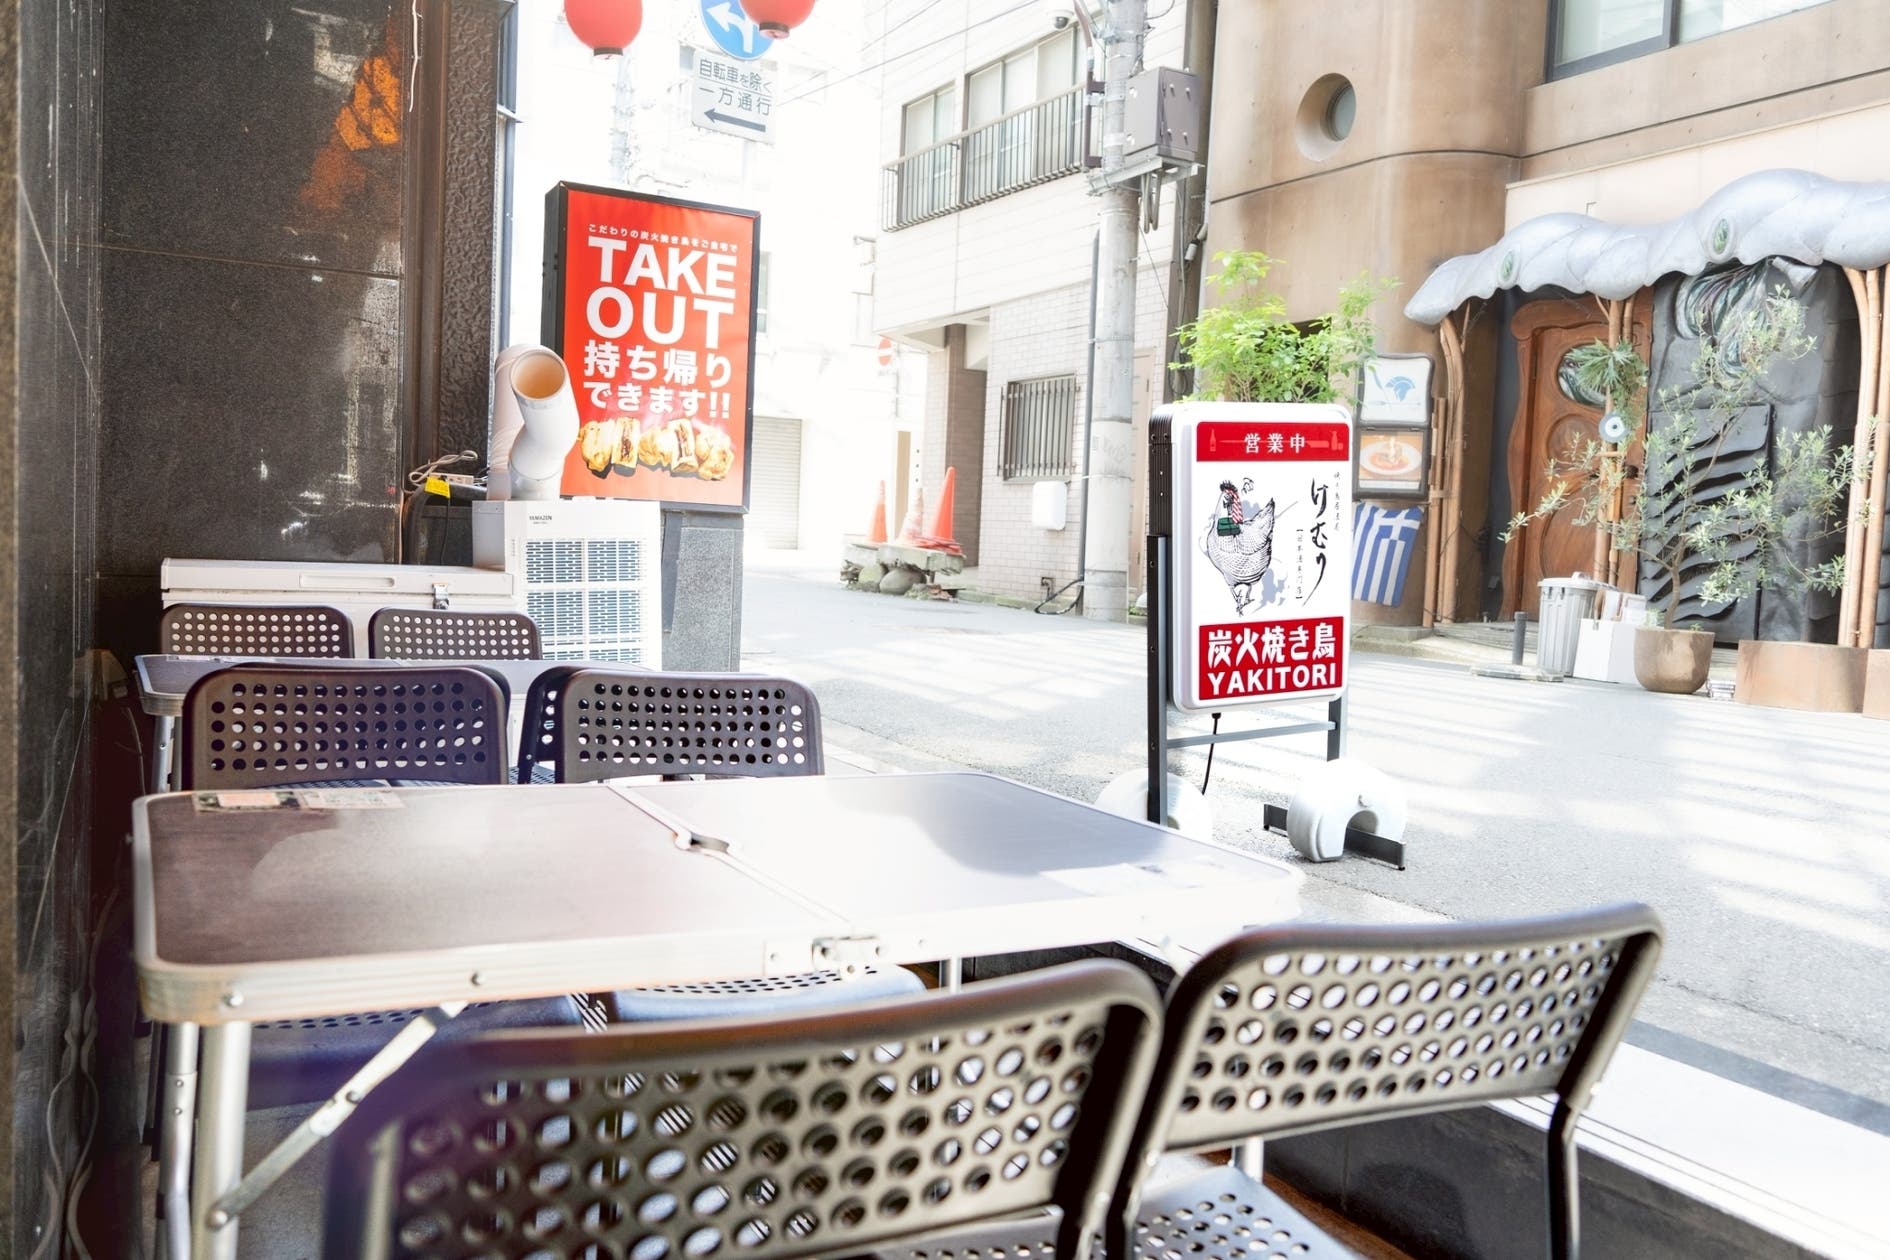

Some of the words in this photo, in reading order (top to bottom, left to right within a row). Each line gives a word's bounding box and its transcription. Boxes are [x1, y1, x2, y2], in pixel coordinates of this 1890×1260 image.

[699, 58, 773, 93] 自転車を除く
[699, 86, 772, 116] 一方通行
[588, 236, 737, 300] TAKE
[586, 286, 735, 349] OUT
[583, 339, 732, 389] 持ち帰り
[1244, 433, 1306, 455] 営業中
[1302, 477, 1329, 607] けむり
[1207, 622, 1337, 669] 炭火焼き鳥
[1207, 663, 1337, 697] YAKITORI
